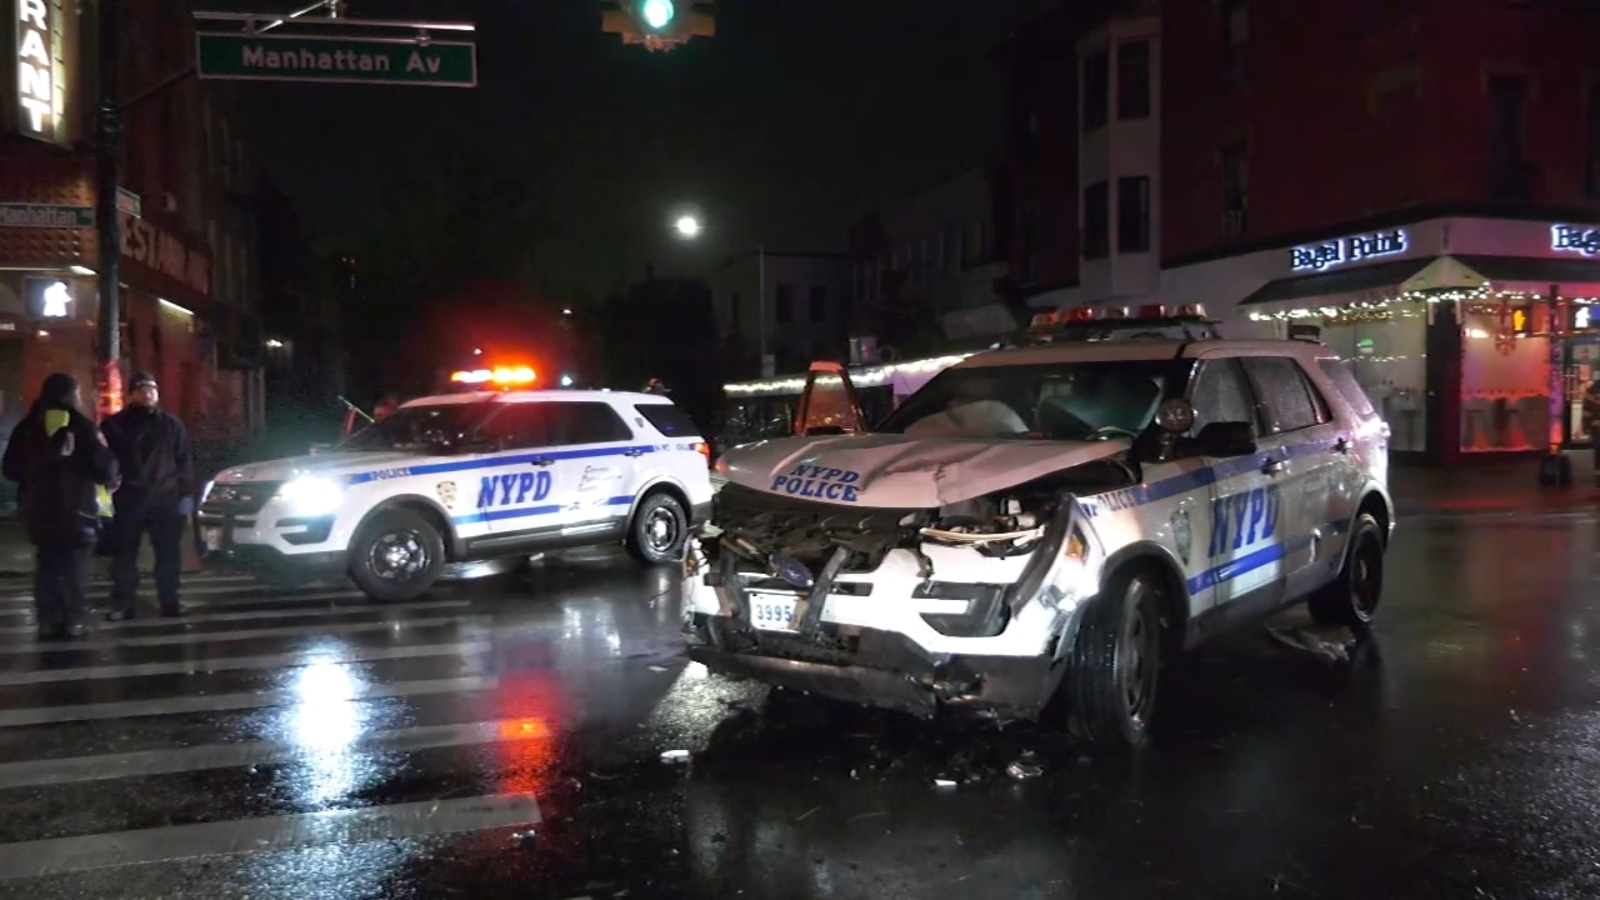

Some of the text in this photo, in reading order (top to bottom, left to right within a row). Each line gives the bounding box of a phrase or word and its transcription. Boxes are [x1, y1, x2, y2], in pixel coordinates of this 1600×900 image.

[20, 0, 51, 132] RANT
[241, 46, 441, 73] Manhattan Av
[1289, 229, 1406, 271] Bagel Point
[373, 467, 411, 481] POLICE
[476, 470, 552, 508] NYPD
[771, 475, 861, 501] POLICE
[790, 464, 860, 483] NYPD
[1208, 485, 1280, 558] NYPD
